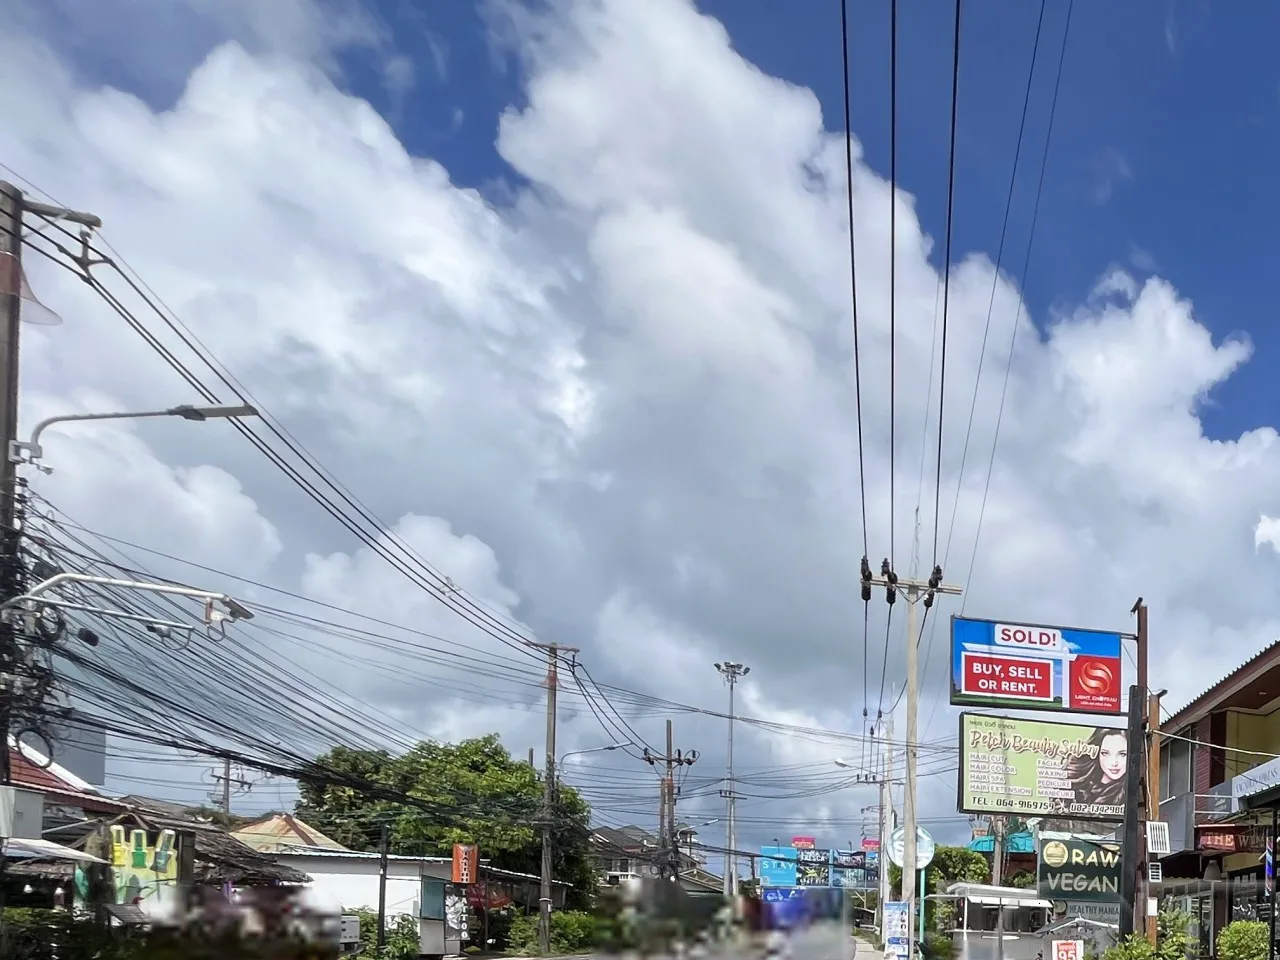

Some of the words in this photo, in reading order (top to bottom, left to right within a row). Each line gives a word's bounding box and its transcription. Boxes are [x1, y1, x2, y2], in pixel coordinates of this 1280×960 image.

[1001, 628, 1057, 647] SOLD!
[972, 662, 1005, 678] BUY,
[1008, 665, 1042, 680] SELL
[978, 679, 997, 690] OR
[1001, 681, 1038, 694] RENT.
[970, 730, 1010, 750] Petch
[1012, 736, 1059, 758] Beauty
[1060, 739, 1100, 759] Salon
[970, 753, 988, 762] HAIR
[991, 755, 1005, 764] CUT
[1038, 759, 1062, 768] FACIAL
[970, 763, 988, 772] HAIR
[991, 766, 1016, 775] COLOR
[1038, 770, 1067, 778] WAXING
[970, 773, 988, 782] HAIR
[991, 775, 1005, 783] SPA
[970, 783, 988, 792] HAIR
[991, 786, 1031, 795] EXTENSION
[1038, 780, 1071, 788] PEDICURE
[1038, 790, 1074, 799] MANICURE
[972, 797, 988, 806] TEL
[1206, 833, 1234, 845] THE
[1072, 849, 1119, 868] RAW
[763, 861, 794, 870] STAY
[1047, 873, 1119, 893] VEGAN
[1069, 905, 1097, 914] HEALTHY
[1099, 906, 1119, 915] MANIA
